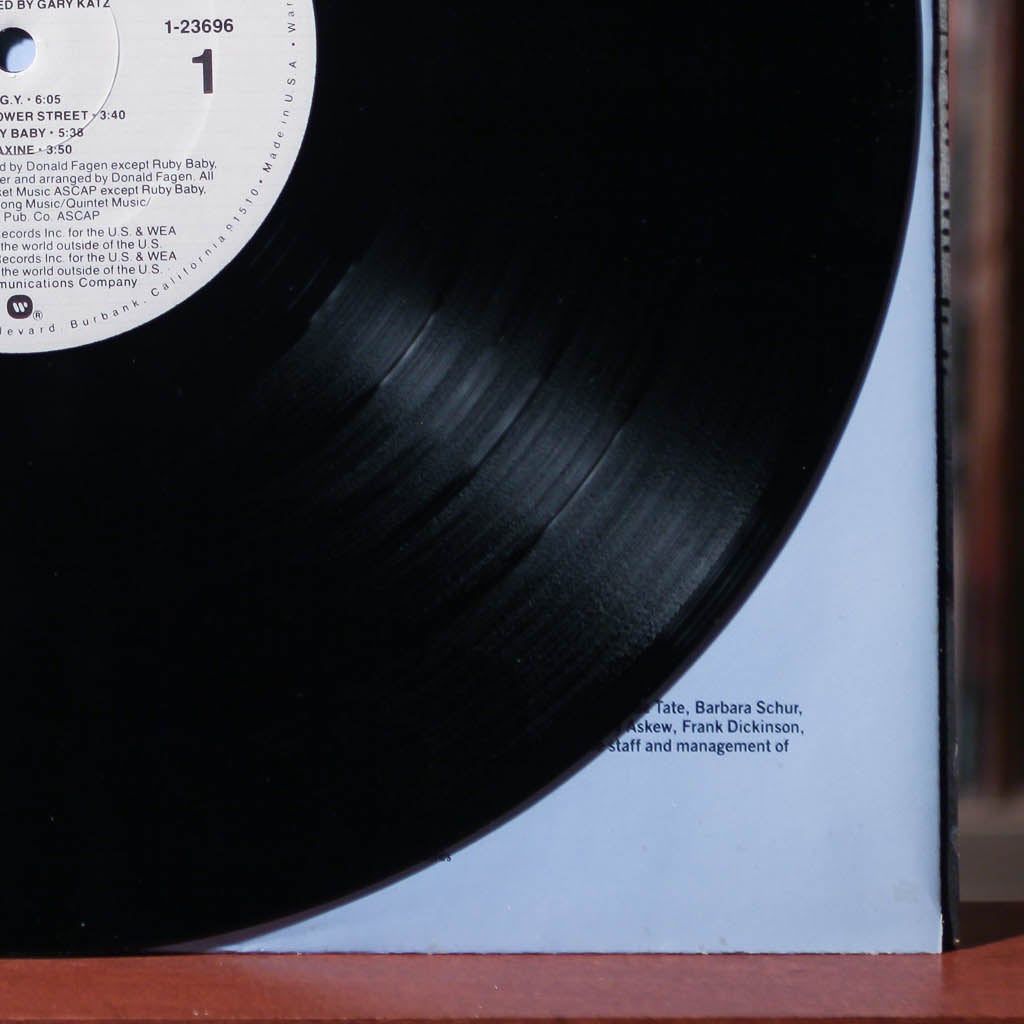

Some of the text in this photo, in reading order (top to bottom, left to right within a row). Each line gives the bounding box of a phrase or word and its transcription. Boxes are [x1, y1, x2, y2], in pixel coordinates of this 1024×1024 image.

[17, 0, 33, 9] BY
[164, 18, 233, 33] 1-23696
[191, 48, 213, 94] 1
[35, 94, 60, 104] 6:05
[37, 110, 88, 121] STREET
[100, 110, 126, 121] 3:40
[10, 127, 45, 138] BABY
[58, 127, 84, 138] 5:38
[46, 144, 72, 155] 3:50
[9, 161, 22, 174] by
[26, 160, 67, 171] Donald
[71, 160, 107, 173] Fagen
[110, 159, 149, 173] except
[152, 158, 182, 172] Ruby
[56, 210, 100, 221] ASCAP
[0, 240, 18, 251] the
[21, 240, 53, 251] world
[56, 239, 99, 250] outside
[102, 238, 113, 249] of
[116, 238, 134, 249] the
[78, 277, 137, 290] Company
[695, 700, 751, 714] Barbara
[682, 719, 723, 733] Frank
[727, 719, 804, 734] Dickinson,
[645, 738, 671, 752] and
[676, 739, 771, 755] management
[775, 739, 789, 752] of
